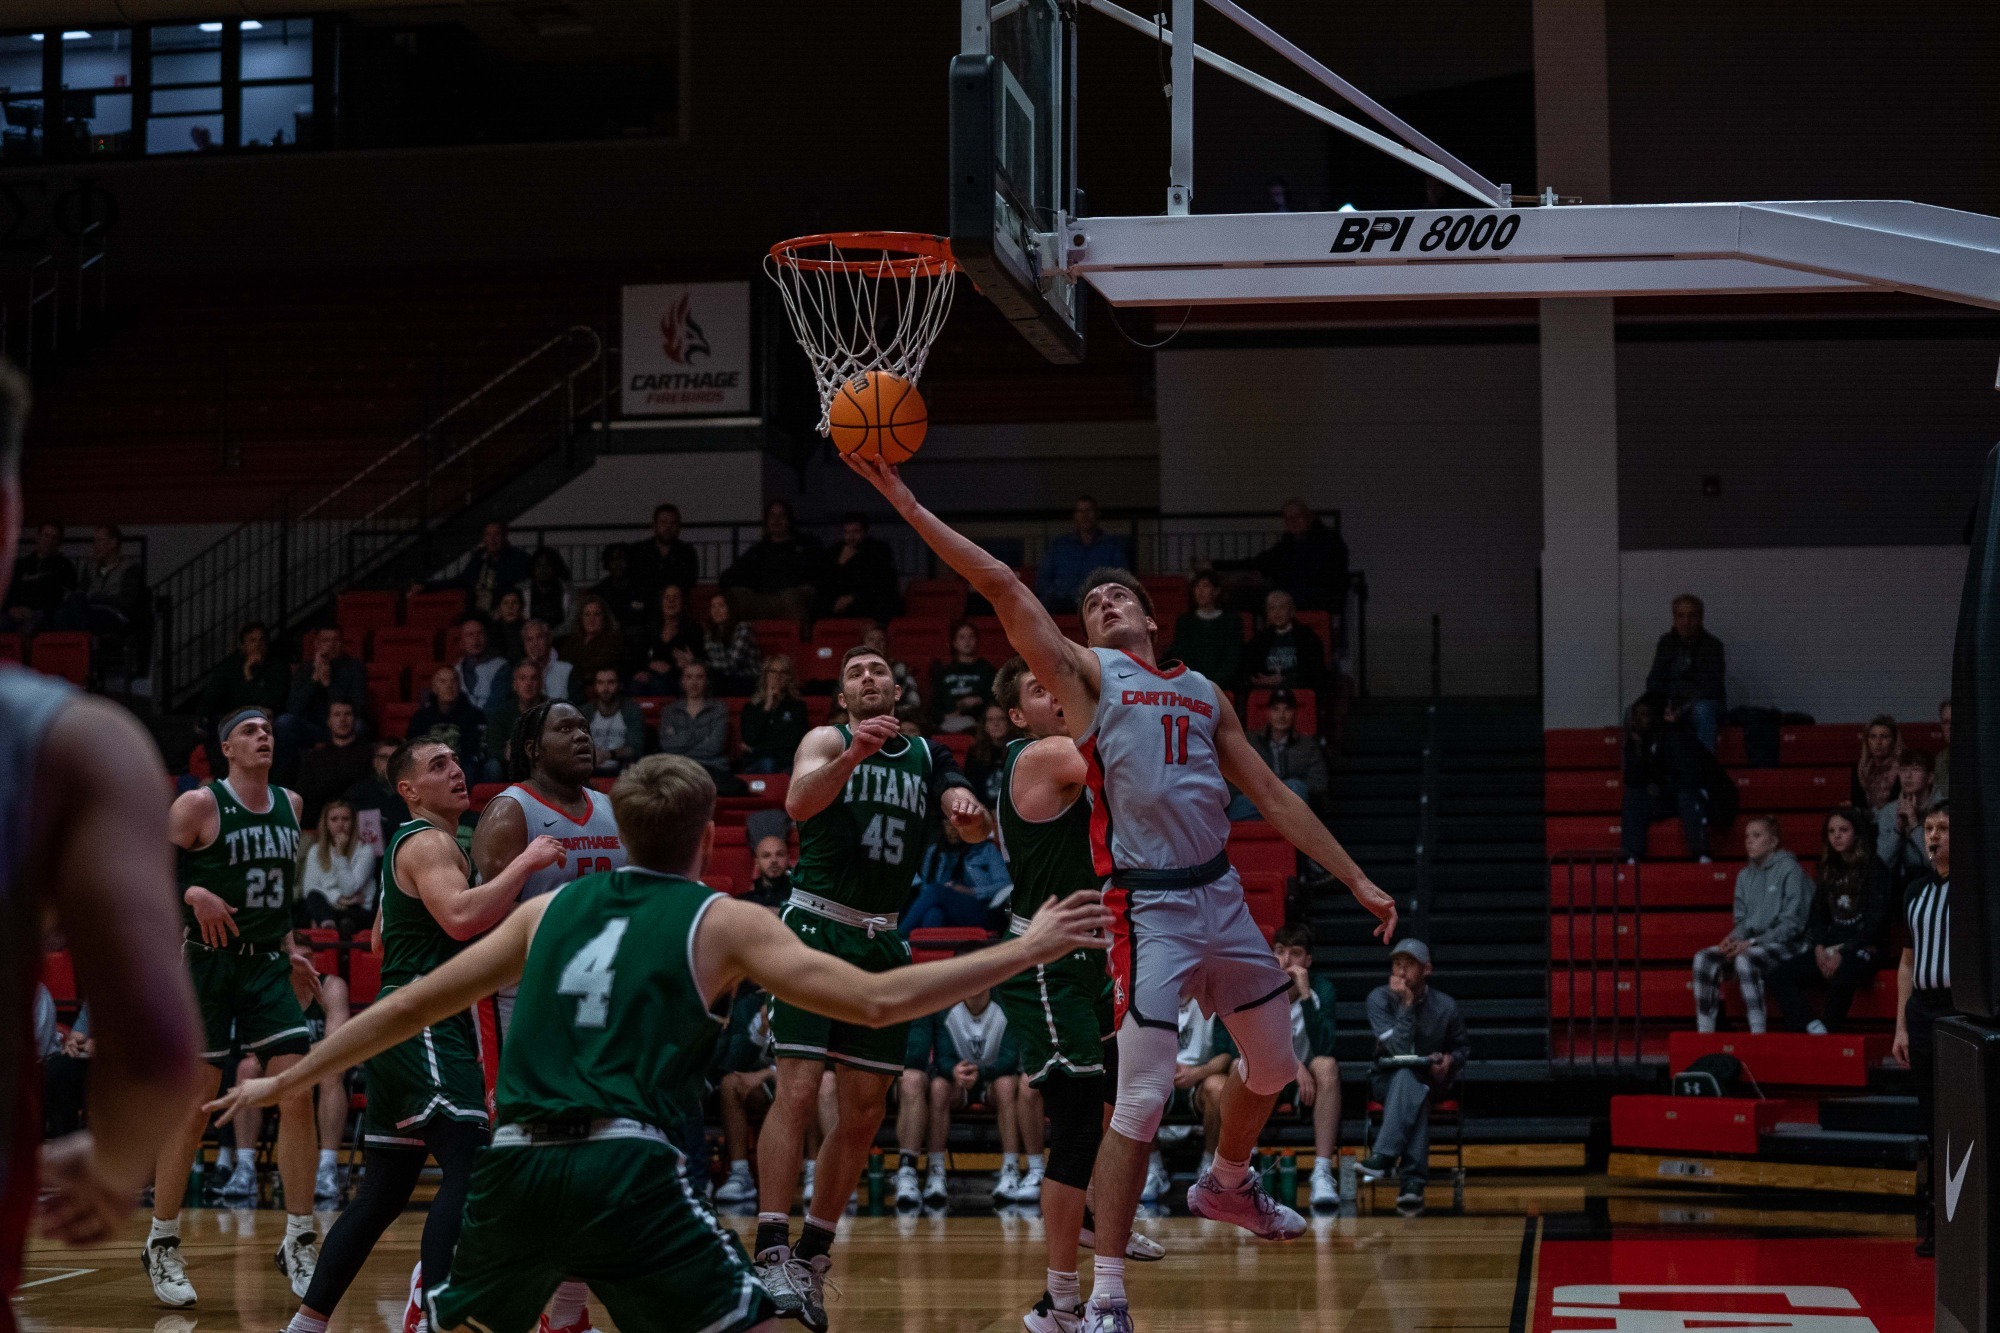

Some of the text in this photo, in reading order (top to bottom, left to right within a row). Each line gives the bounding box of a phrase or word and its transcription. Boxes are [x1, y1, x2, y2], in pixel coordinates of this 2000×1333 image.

[1329, 214, 1521, 253] BPI 8000
[630, 372, 740, 391] CARTHAGE
[1122, 690, 1213, 719] CARTHAGE
[1161, 714, 1190, 765] 11
[843, 763, 929, 820] TITANS
[224, 824, 300, 867] TITANS
[860, 812, 907, 866] 45
[245, 867, 284, 909] 23
[556, 916, 631, 1029] 4
